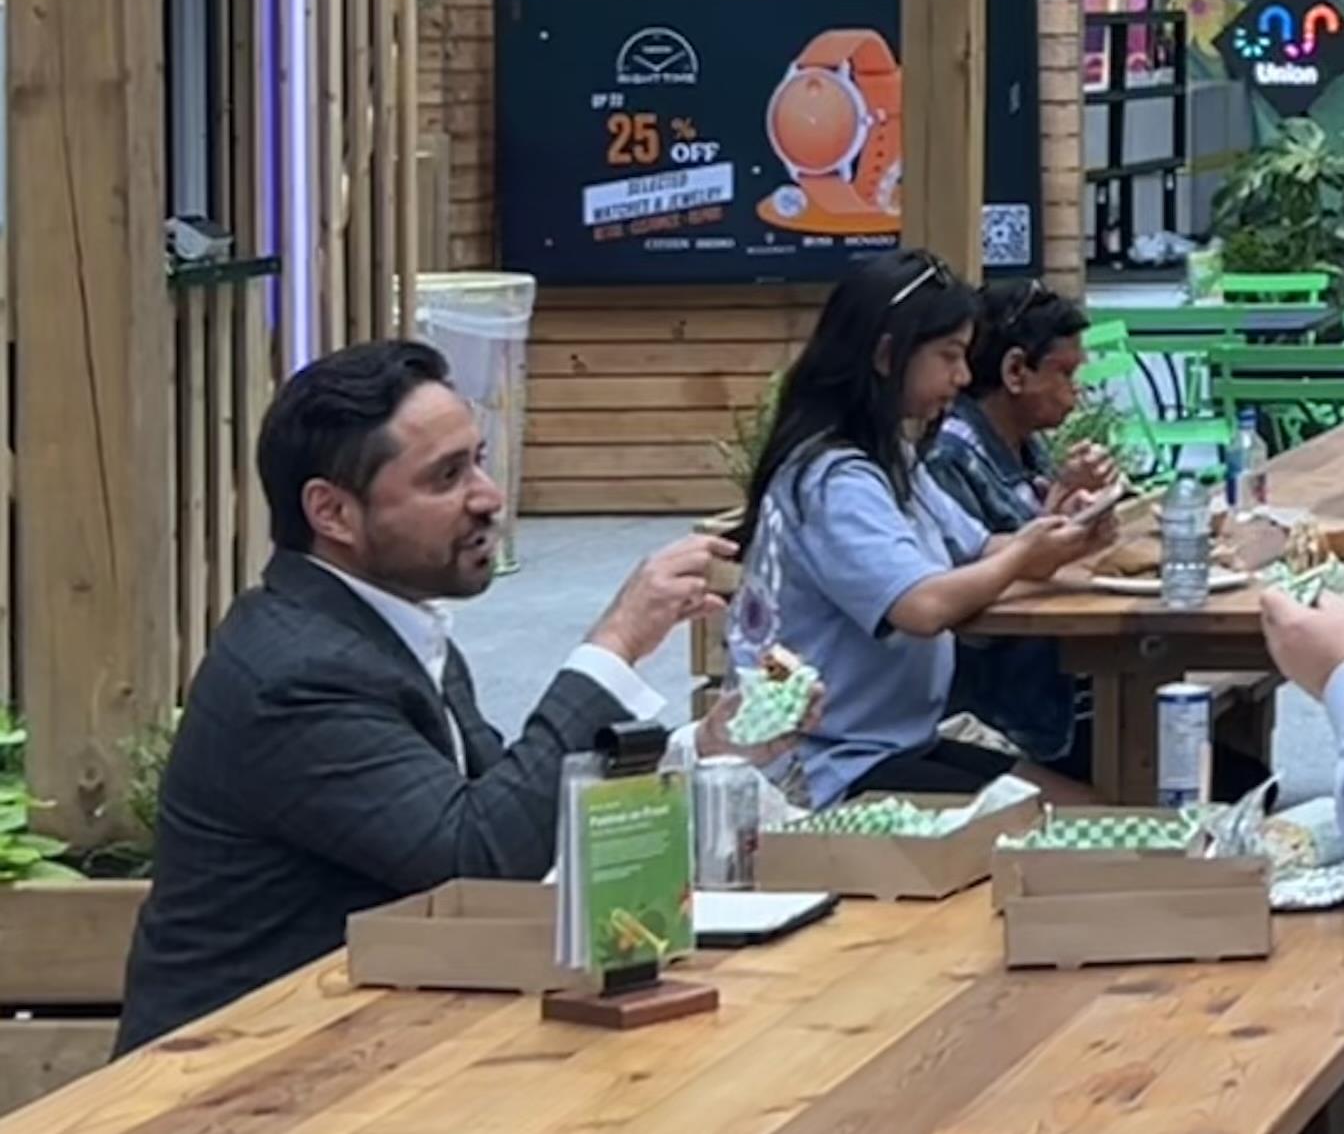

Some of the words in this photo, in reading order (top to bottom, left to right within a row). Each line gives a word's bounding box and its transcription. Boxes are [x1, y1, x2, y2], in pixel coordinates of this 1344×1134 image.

[1255, 62, 1319, 85] Union
[607, 113, 660, 164] 25
[670, 117, 697, 140] %
[670, 142, 720, 163] OFF
